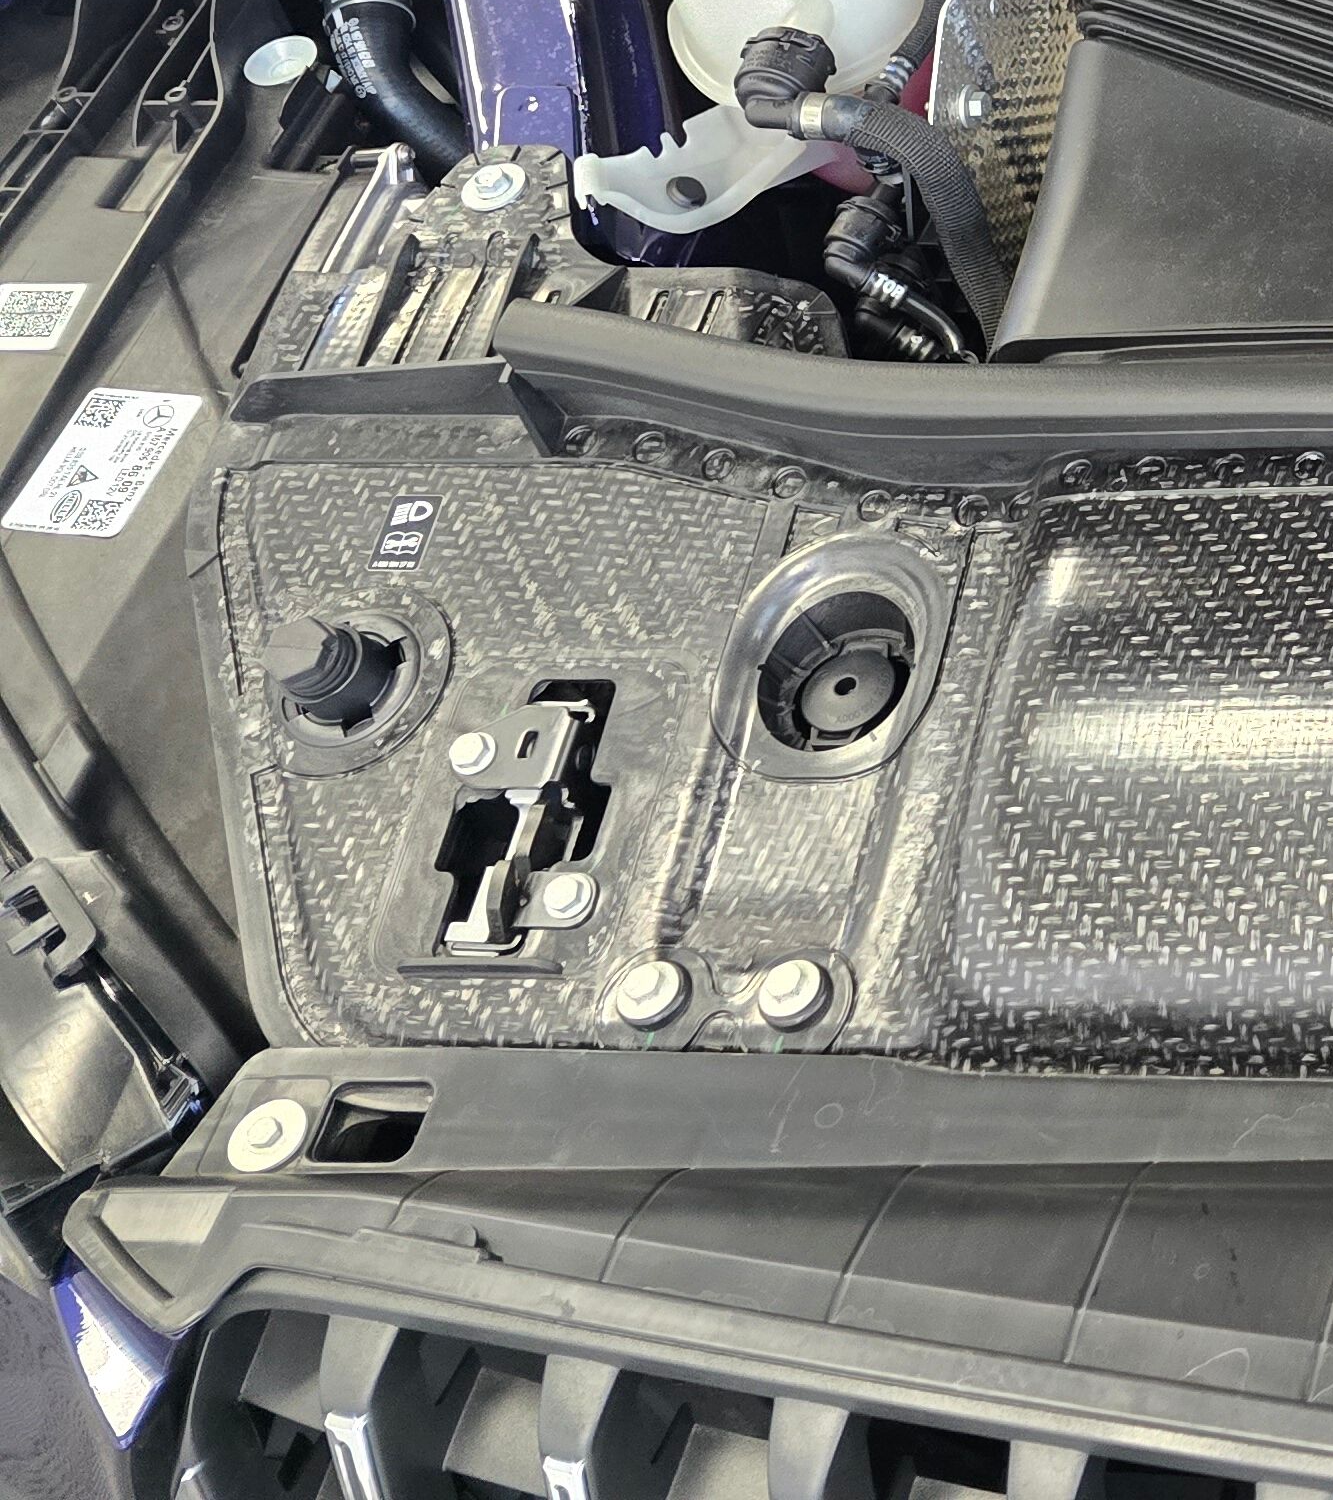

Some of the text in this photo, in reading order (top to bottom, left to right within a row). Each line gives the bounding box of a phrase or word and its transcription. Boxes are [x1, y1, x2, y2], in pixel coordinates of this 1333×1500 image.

[142, 427, 179, 471] Mercedes
[113, 467, 129, 482] LED
[103, 482, 120, 496] 12V
[116, 480, 133, 493] 09
[122, 479, 145, 502] Benz
[51, 491, 79, 524] HELLA
